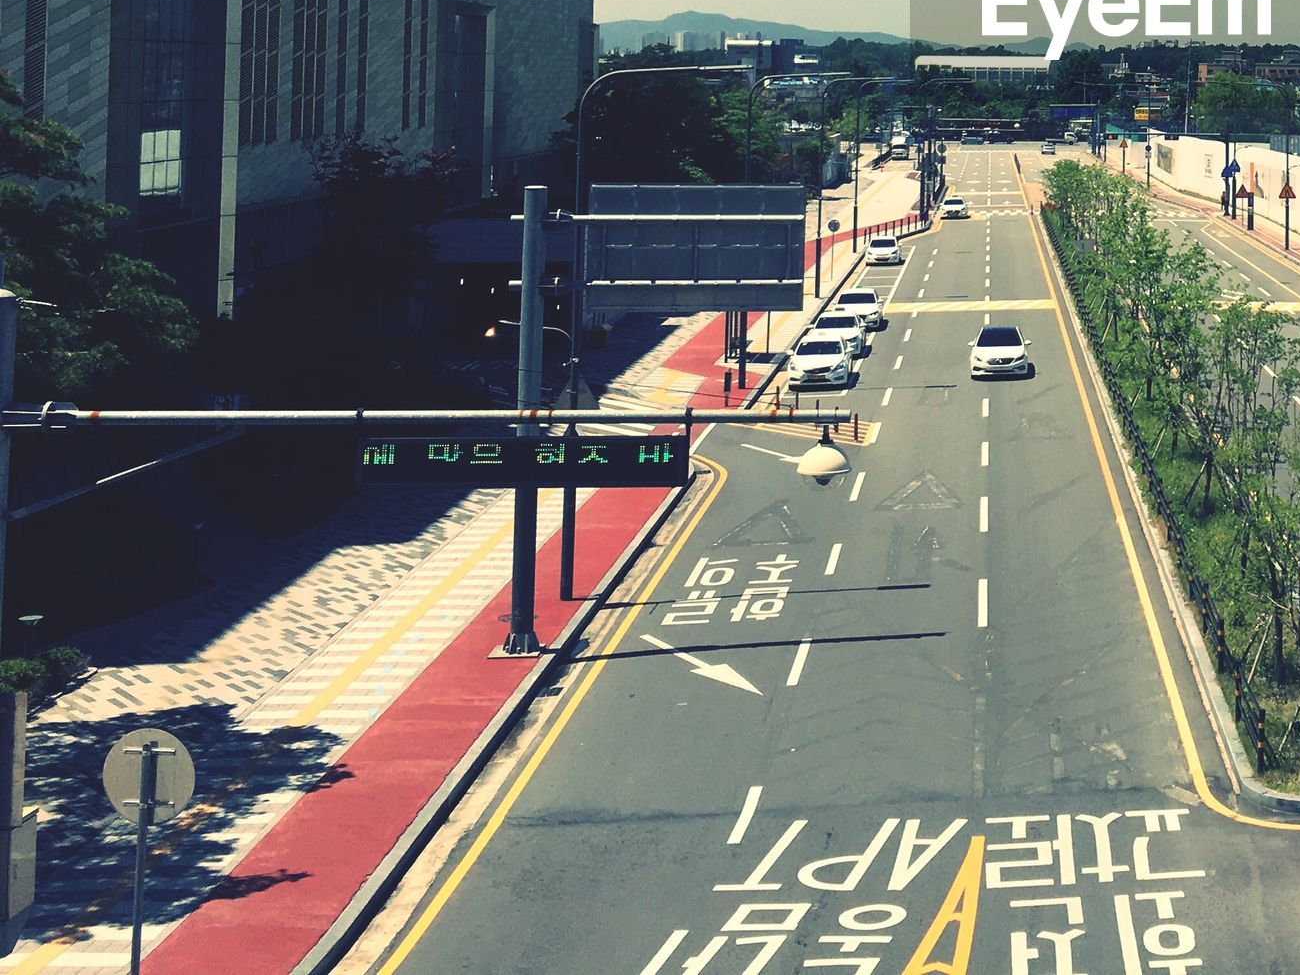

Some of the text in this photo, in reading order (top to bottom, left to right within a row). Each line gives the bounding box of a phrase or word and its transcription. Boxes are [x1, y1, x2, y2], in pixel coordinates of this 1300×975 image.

[684, 553, 800, 587] 주의
[661, 586, 790, 626] 합류
[711, 818, 969, 892] APT
[984, 808, 1207, 889] 교차로
